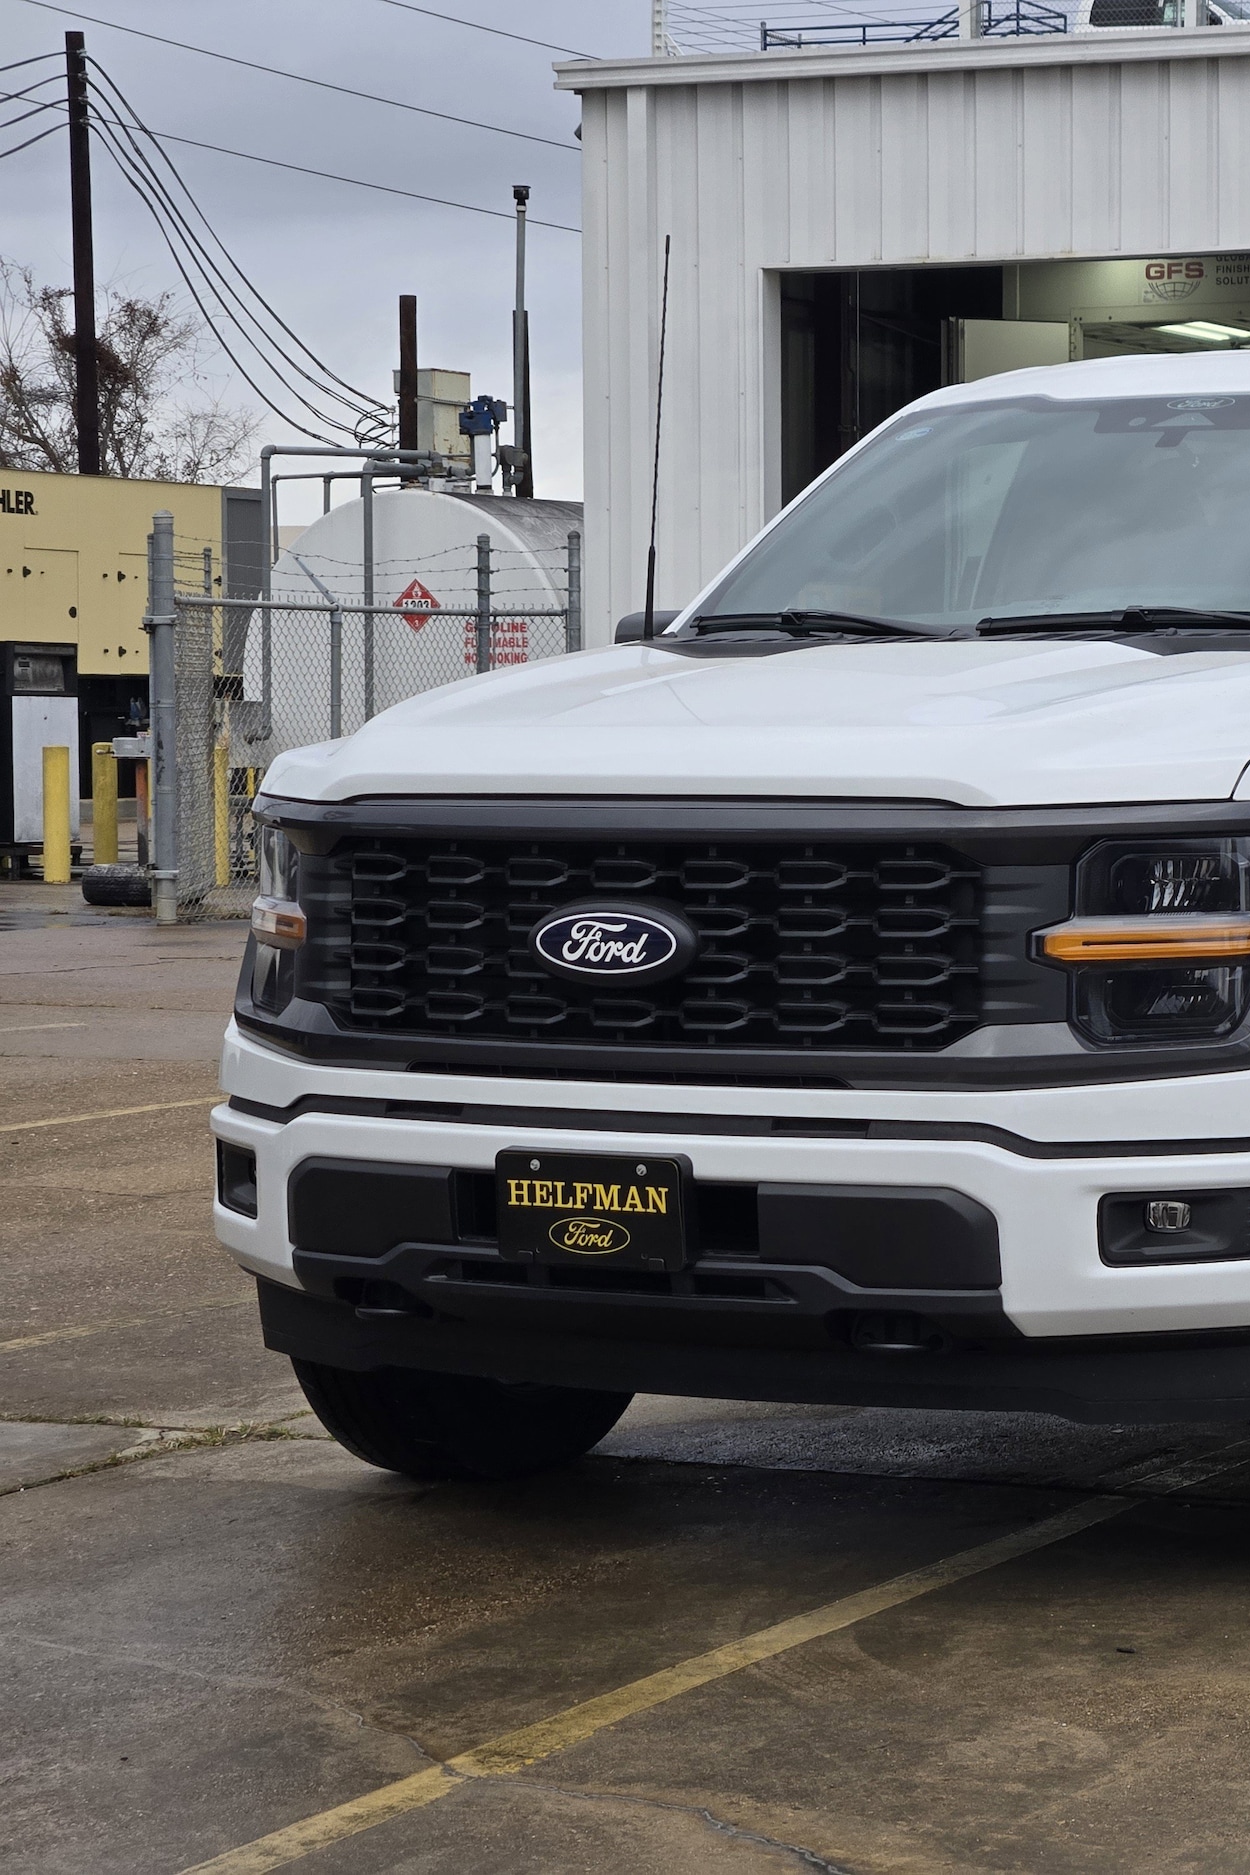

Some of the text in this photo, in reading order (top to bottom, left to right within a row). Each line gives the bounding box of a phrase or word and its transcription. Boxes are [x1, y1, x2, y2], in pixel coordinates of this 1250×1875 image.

[1145, 261, 1204, 281] GFS
[464, 622, 528, 633] GOLINE
[464, 652, 478, 664] NO
[561, 920, 650, 964] Ford
[506, 1179, 670, 1215] HELFMAN
[563, 1220, 614, 1249] Ford
